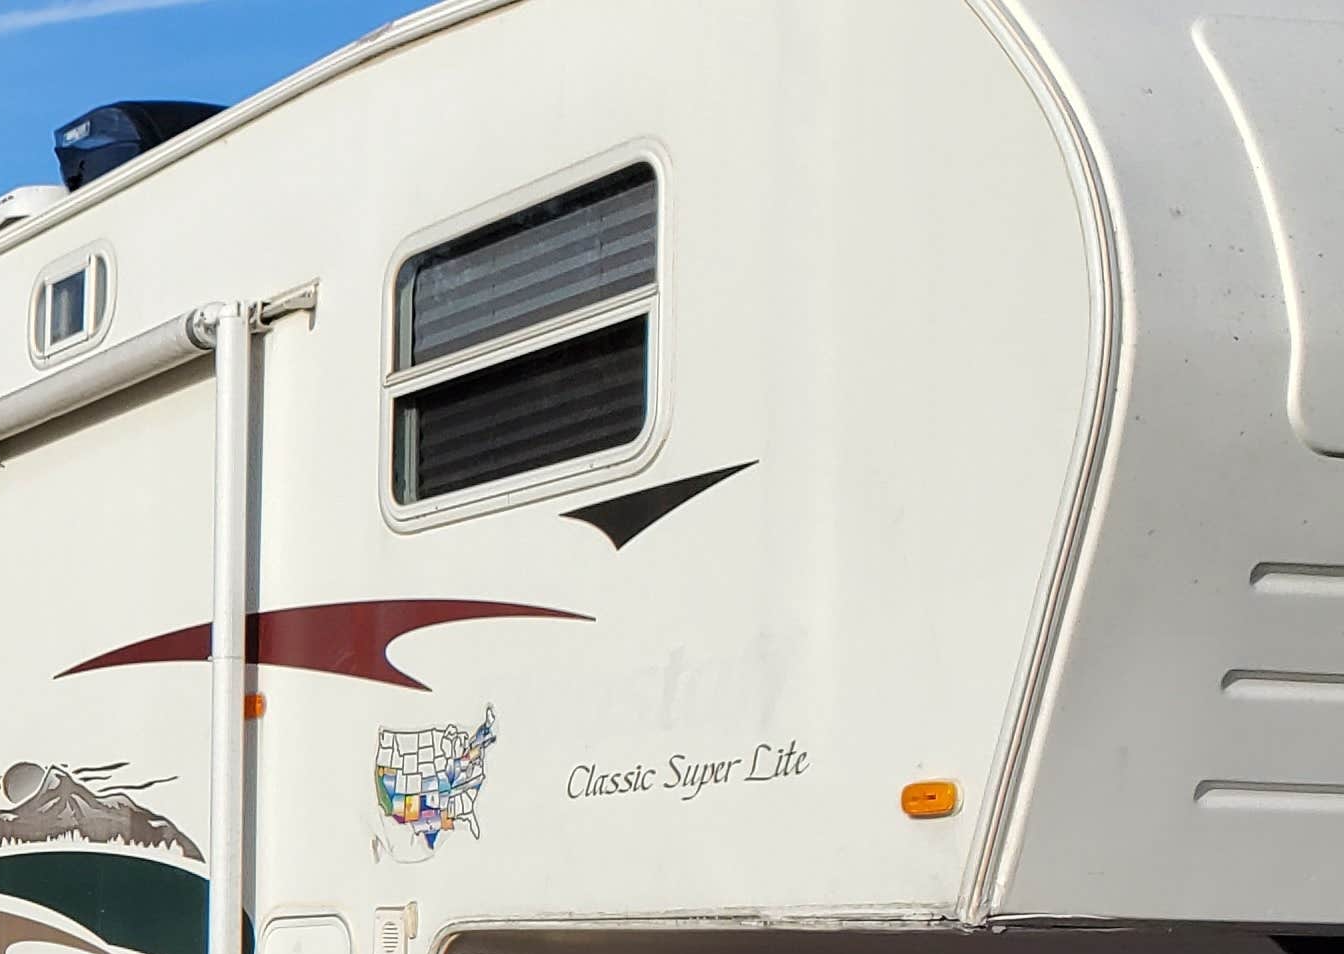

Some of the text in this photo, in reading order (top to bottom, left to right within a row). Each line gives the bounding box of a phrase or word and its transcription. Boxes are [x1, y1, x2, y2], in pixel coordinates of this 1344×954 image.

[566, 740, 811, 801] Classic Super Lite
